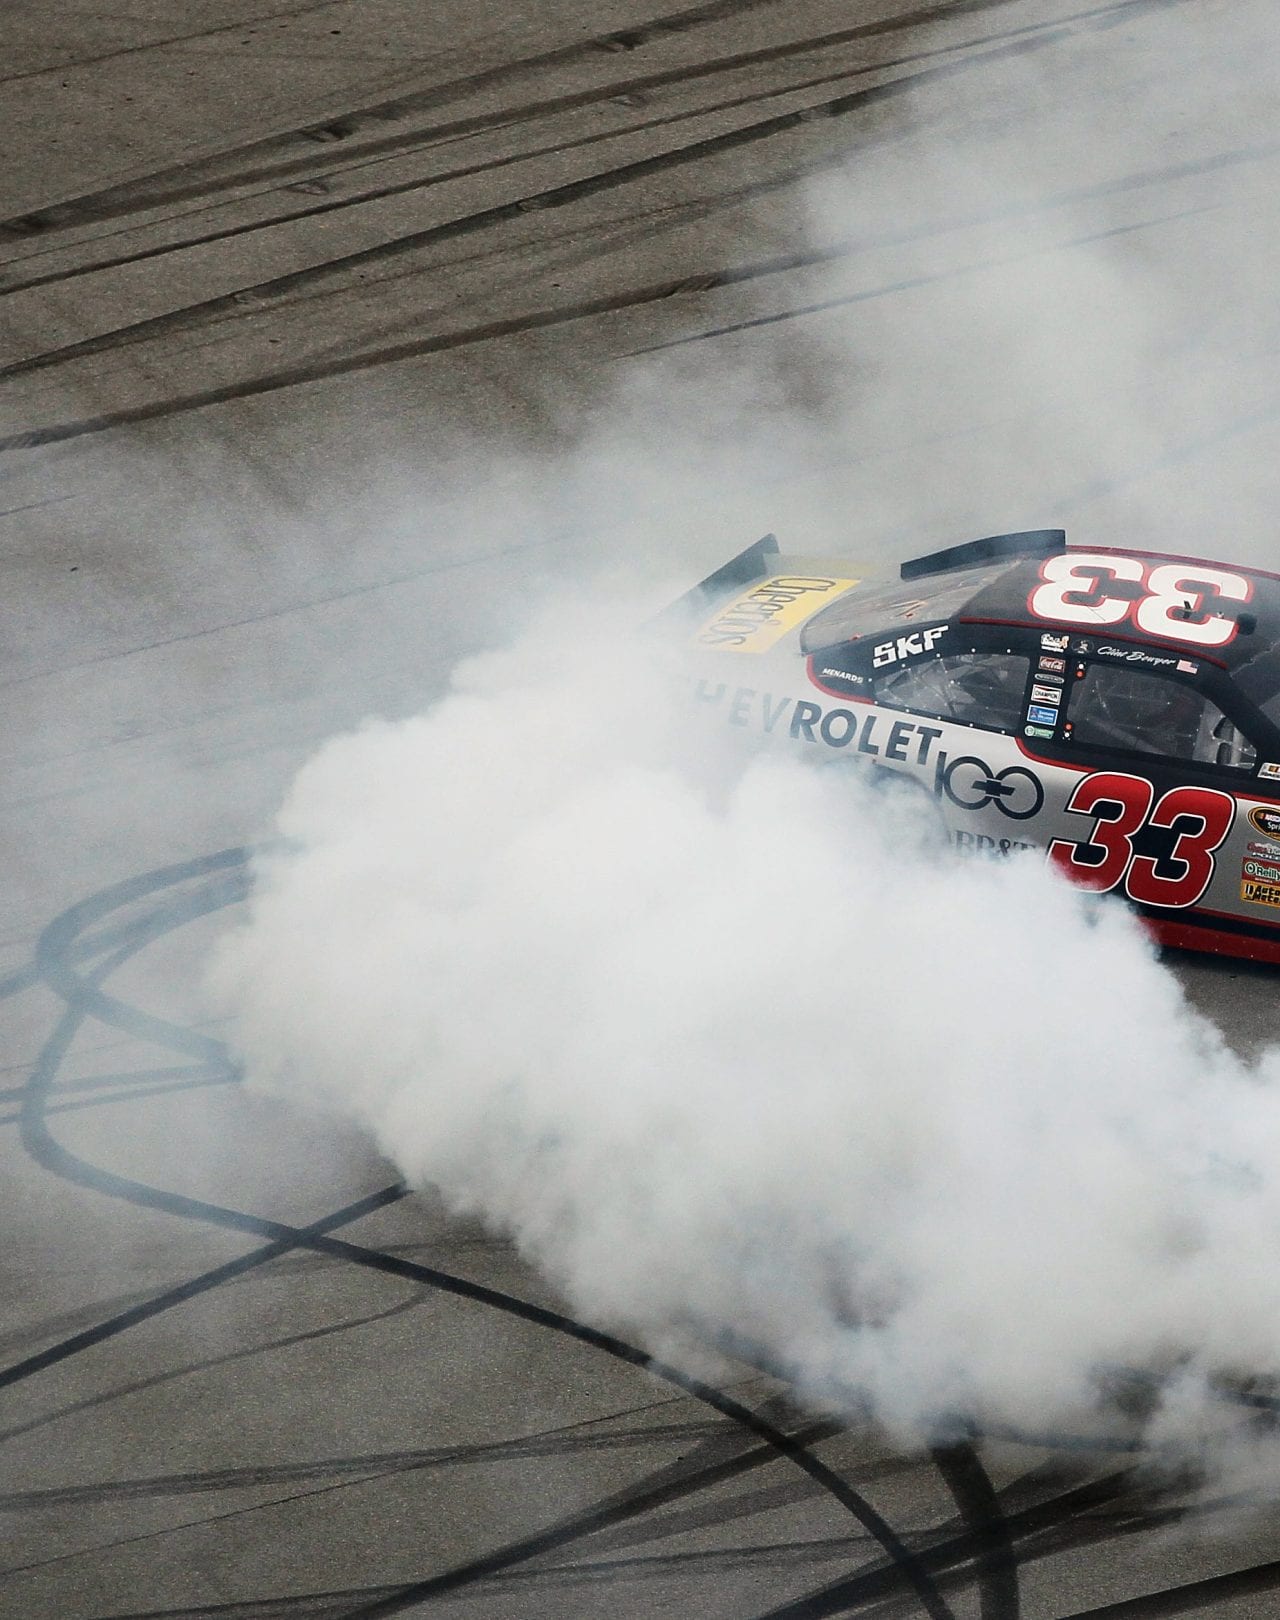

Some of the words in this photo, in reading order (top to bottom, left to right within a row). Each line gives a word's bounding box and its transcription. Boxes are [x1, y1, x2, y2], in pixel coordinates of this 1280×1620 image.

[701, 577, 836, 645] Cheerios
[1030, 553, 1250, 645] 33
[823, 668, 863, 683] MENARDS
[873, 625, 949, 668] SKF
[693, 679, 943, 765] HEVROLET
[1046, 771, 1236, 908] 33
